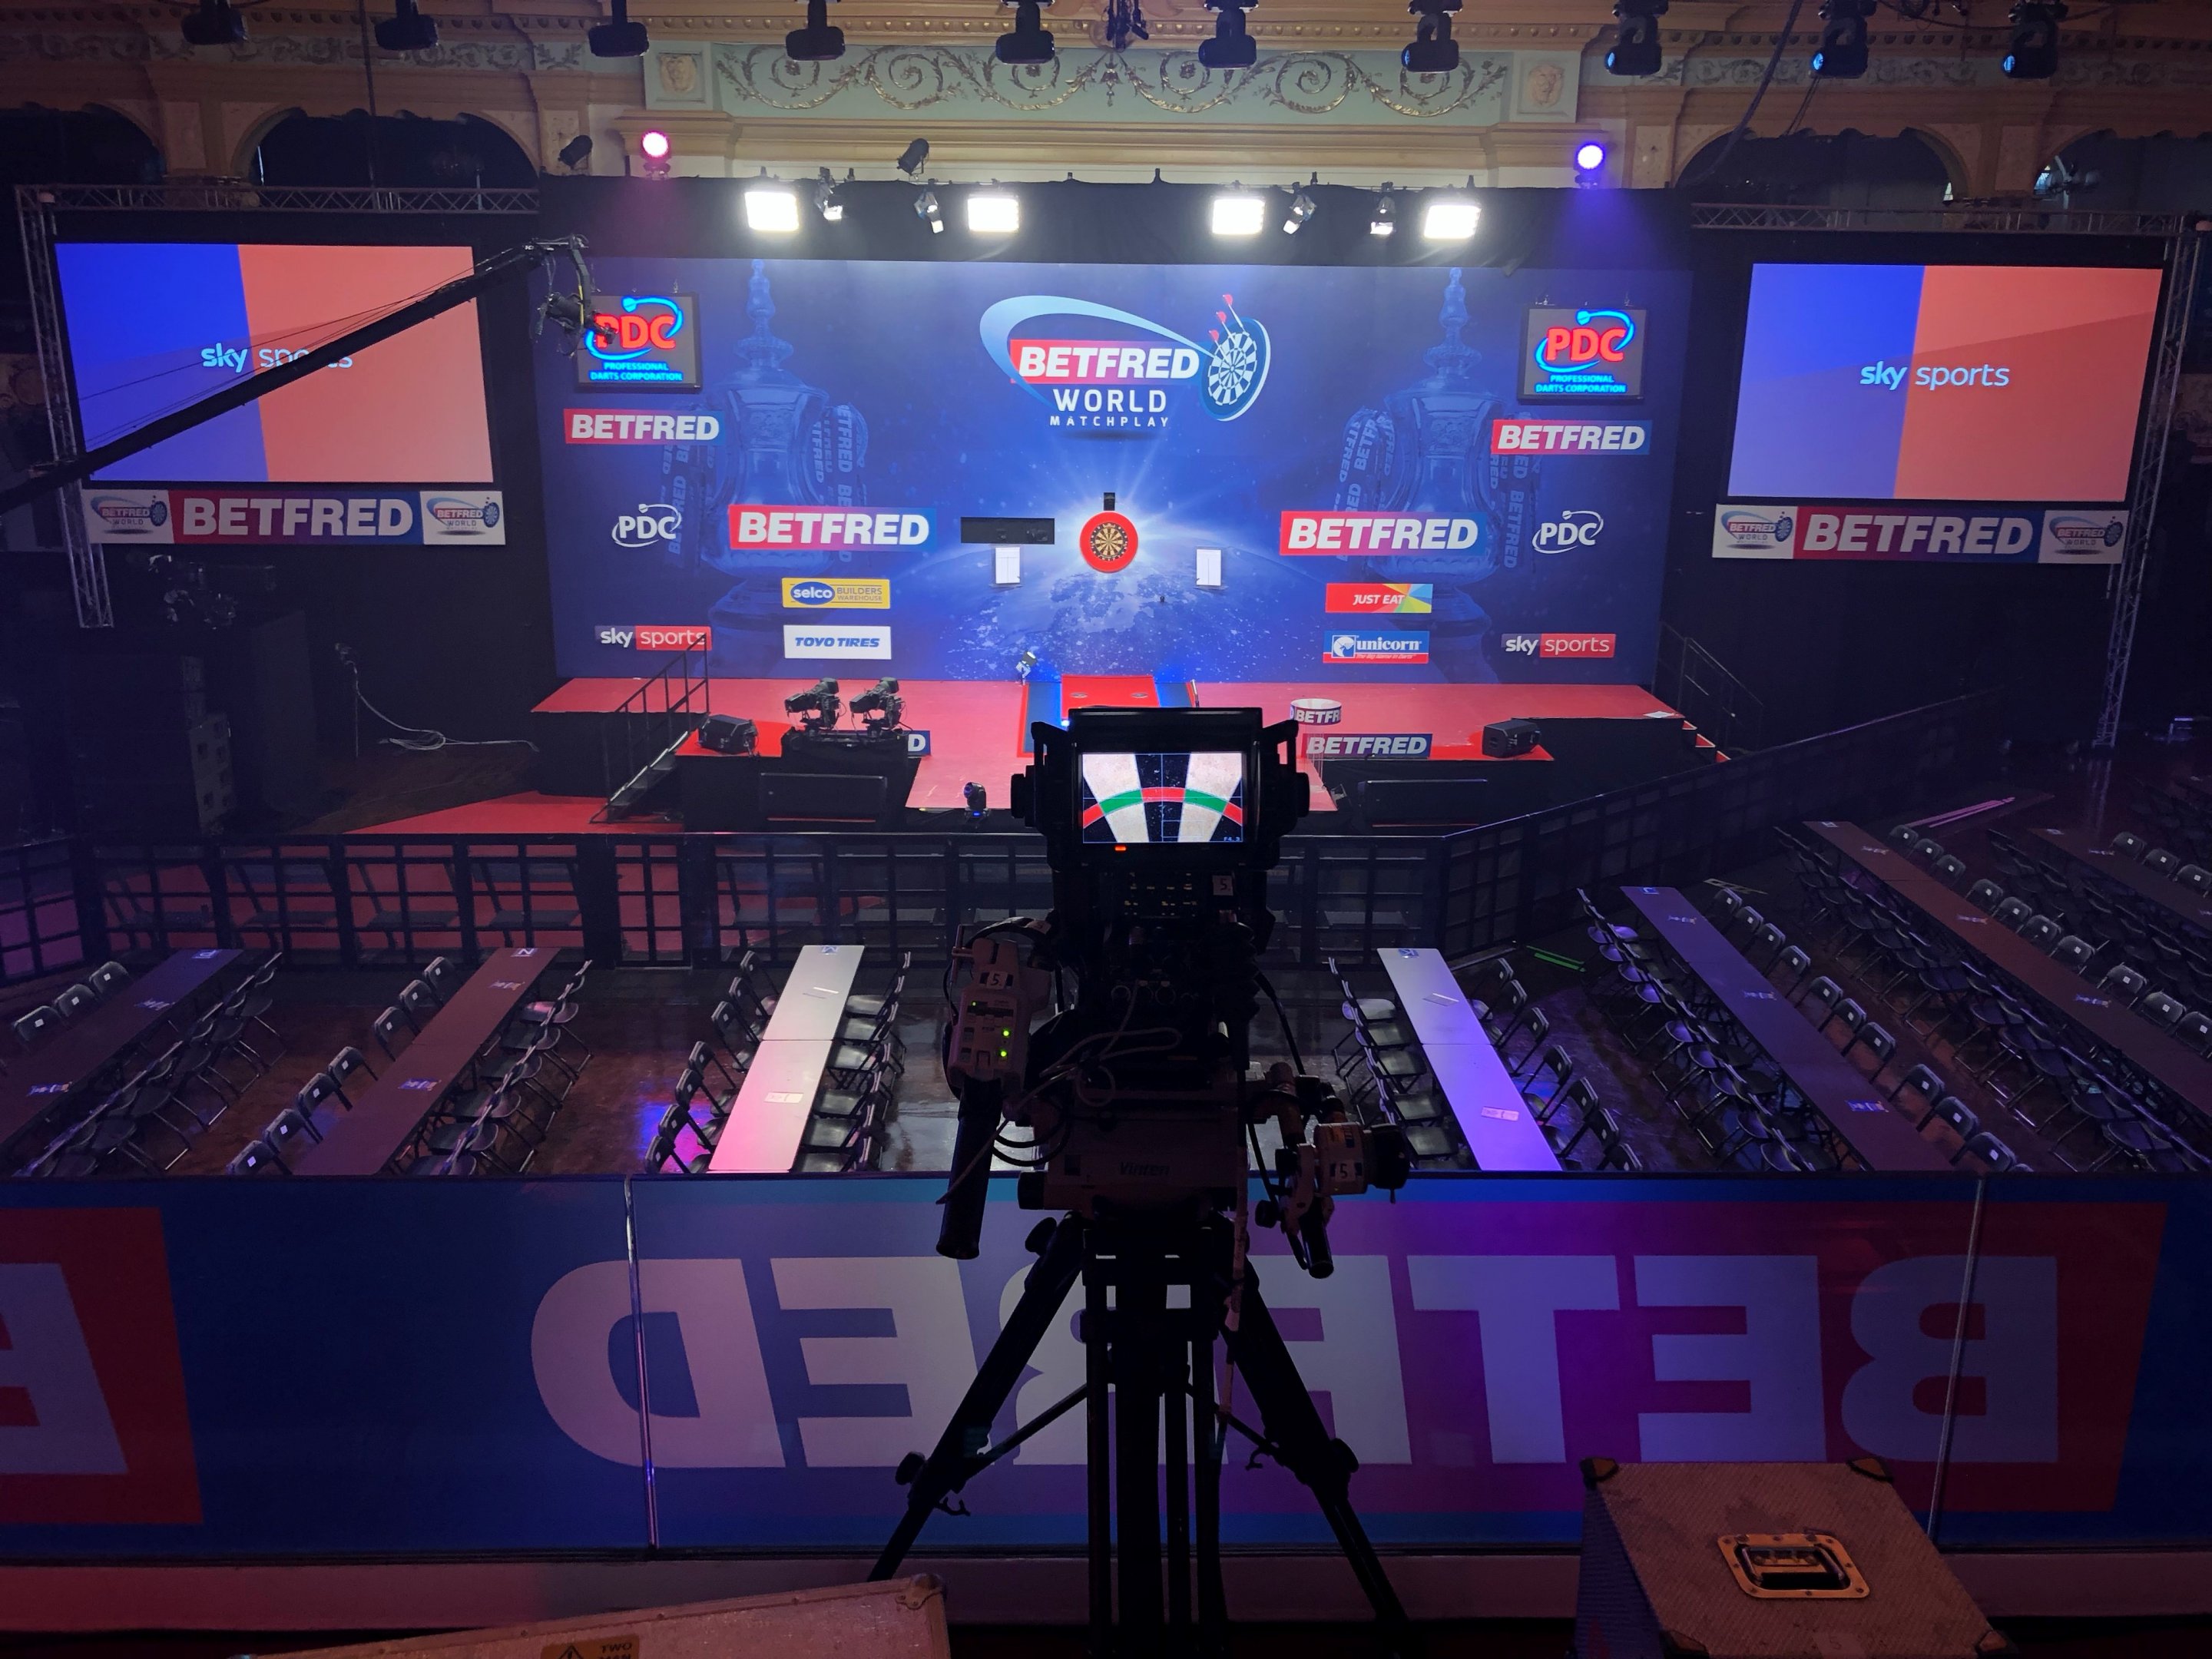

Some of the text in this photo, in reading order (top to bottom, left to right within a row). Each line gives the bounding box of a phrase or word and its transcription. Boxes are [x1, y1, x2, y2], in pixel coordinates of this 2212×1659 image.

[594, 315, 676, 349] PDC
[1546, 326, 1626, 362] PDC
[201, 343, 248, 373] sky
[604, 362, 669, 371] PROFESSIONAL
[1018, 346, 1199, 379] BETFRED
[591, 372, 682, 381] DARTS CORPORATION
[1550, 375, 1614, 383] PROFESSIONAL
[1859, 361, 2010, 390] sky sports
[1535, 384, 1626, 392] DARTS CORPORATION
[1053, 389, 1166, 412] WORLD
[571, 414, 720, 441] BETFRED
[1049, 416, 1169, 427] MATCHPLAY
[1497, 425, 1645, 450] BETFRED
[102, 508, 150, 518] BETFRED
[183, 498, 412, 536] BETFRED
[436, 509, 483, 518] BETFRED
[618, 515, 676, 539] PDC
[737, 512, 929, 545] BETFRED
[1287, 517, 1478, 550] BETFRED
[1540, 522, 1597, 546] PDC
[1803, 514, 2033, 554] BETFRED
[793, 586, 833, 598] selco
[1353, 594, 1405, 605] JUST EAT
[600, 628, 705, 647] sky sports
[795, 637, 880, 647] TOYO TIRES
[1356, 637, 1419, 651] unicorn
[1505, 636, 1610, 655] sky sports
[1307, 737, 1427, 754] BETFRED
[1119, 1161, 1171, 1176] Vinten
[1339, 1163, 1348, 1179] 5
[601, 1643, 633, 1654] TWO
